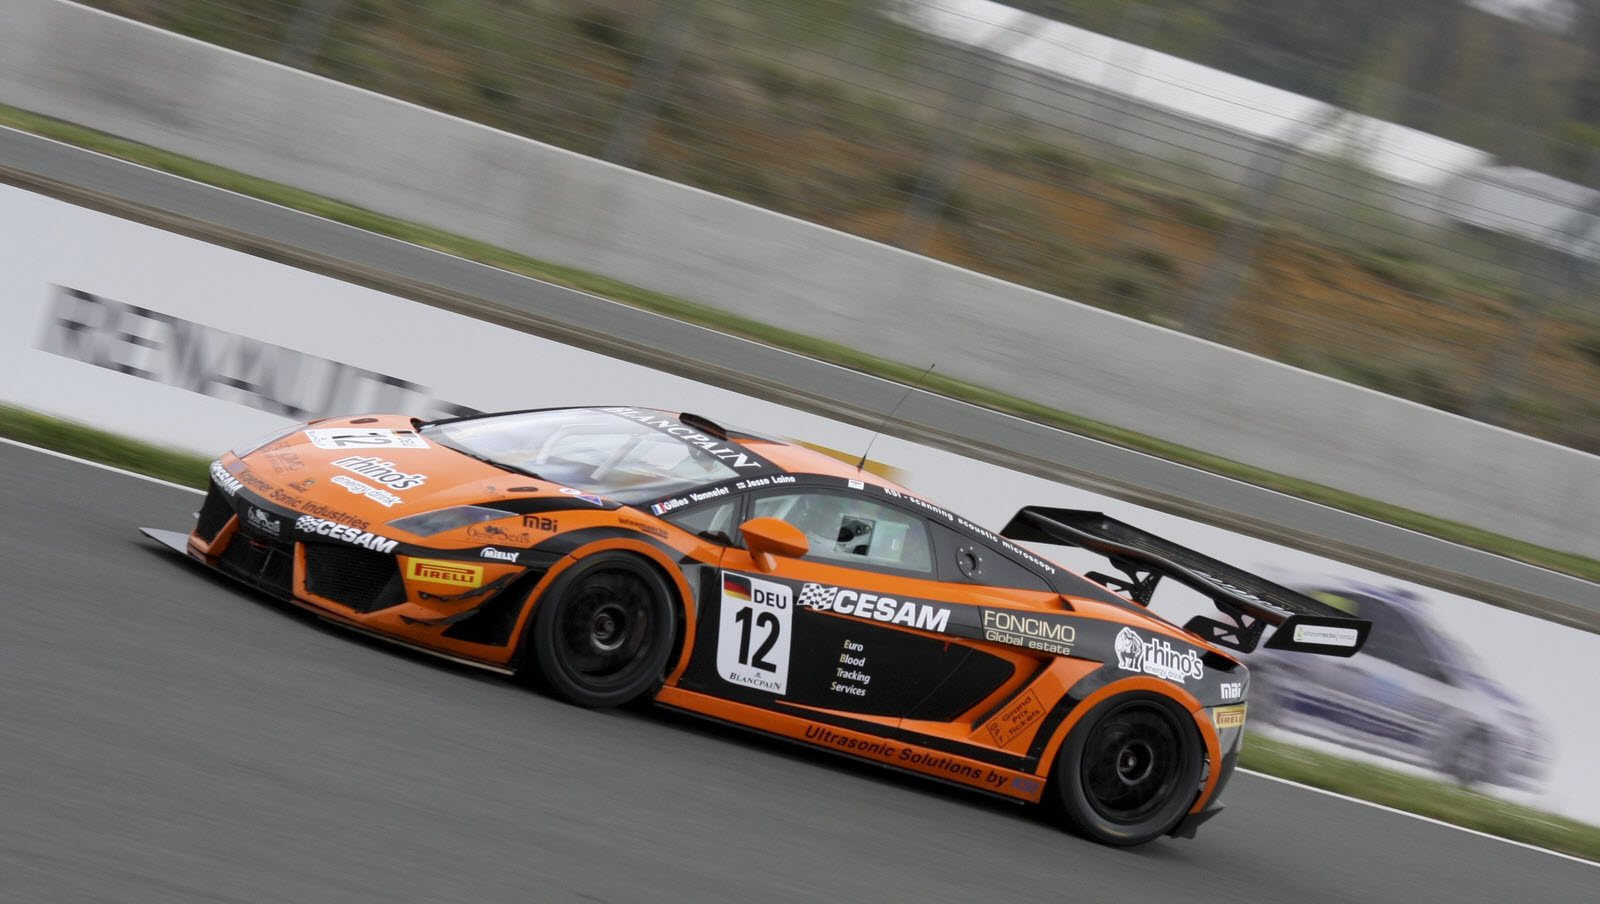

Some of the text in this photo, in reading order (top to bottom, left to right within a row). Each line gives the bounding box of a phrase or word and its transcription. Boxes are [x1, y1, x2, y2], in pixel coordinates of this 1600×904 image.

[600, 406, 762, 468] BLANCPAIN
[333, 476, 399, 506] energy drink
[747, 474, 796, 489] Jesse Laine
[269, 488, 303, 508] Sonic
[300, 502, 371, 530] Industries
[664, 497, 689, 511] Gilles
[316, 520, 400, 554] CESAM
[910, 496, 954, 521] scanning
[957, 517, 998, 542] acoustic
[1002, 540, 1056, 575] microscopy
[414, 562, 476, 584] PIRELLI
[753, 588, 787, 610] DEU
[833, 590, 951, 632] CESAM
[735, 606, 781, 673] 12
[984, 610, 1076, 643] FONCIMO
[843, 639, 864, 652] Euro
[985, 629, 1071, 656] Global estate
[840, 653, 866, 667] Blood
[1144, 639, 1203, 678] rhino's
[729, 672, 782, 691] BLANCPAIN
[830, 681, 867, 697] Services
[836, 667, 871, 685] Tracking
[1002, 696, 1031, 721] Grand
[1012, 709, 1029, 723] Prix
[1008, 709, 1040, 735] Tickets
[805, 725, 895, 757] Ultrasonic
[898, 748, 982, 779] Solutions
[986, 770, 1008, 788] by
